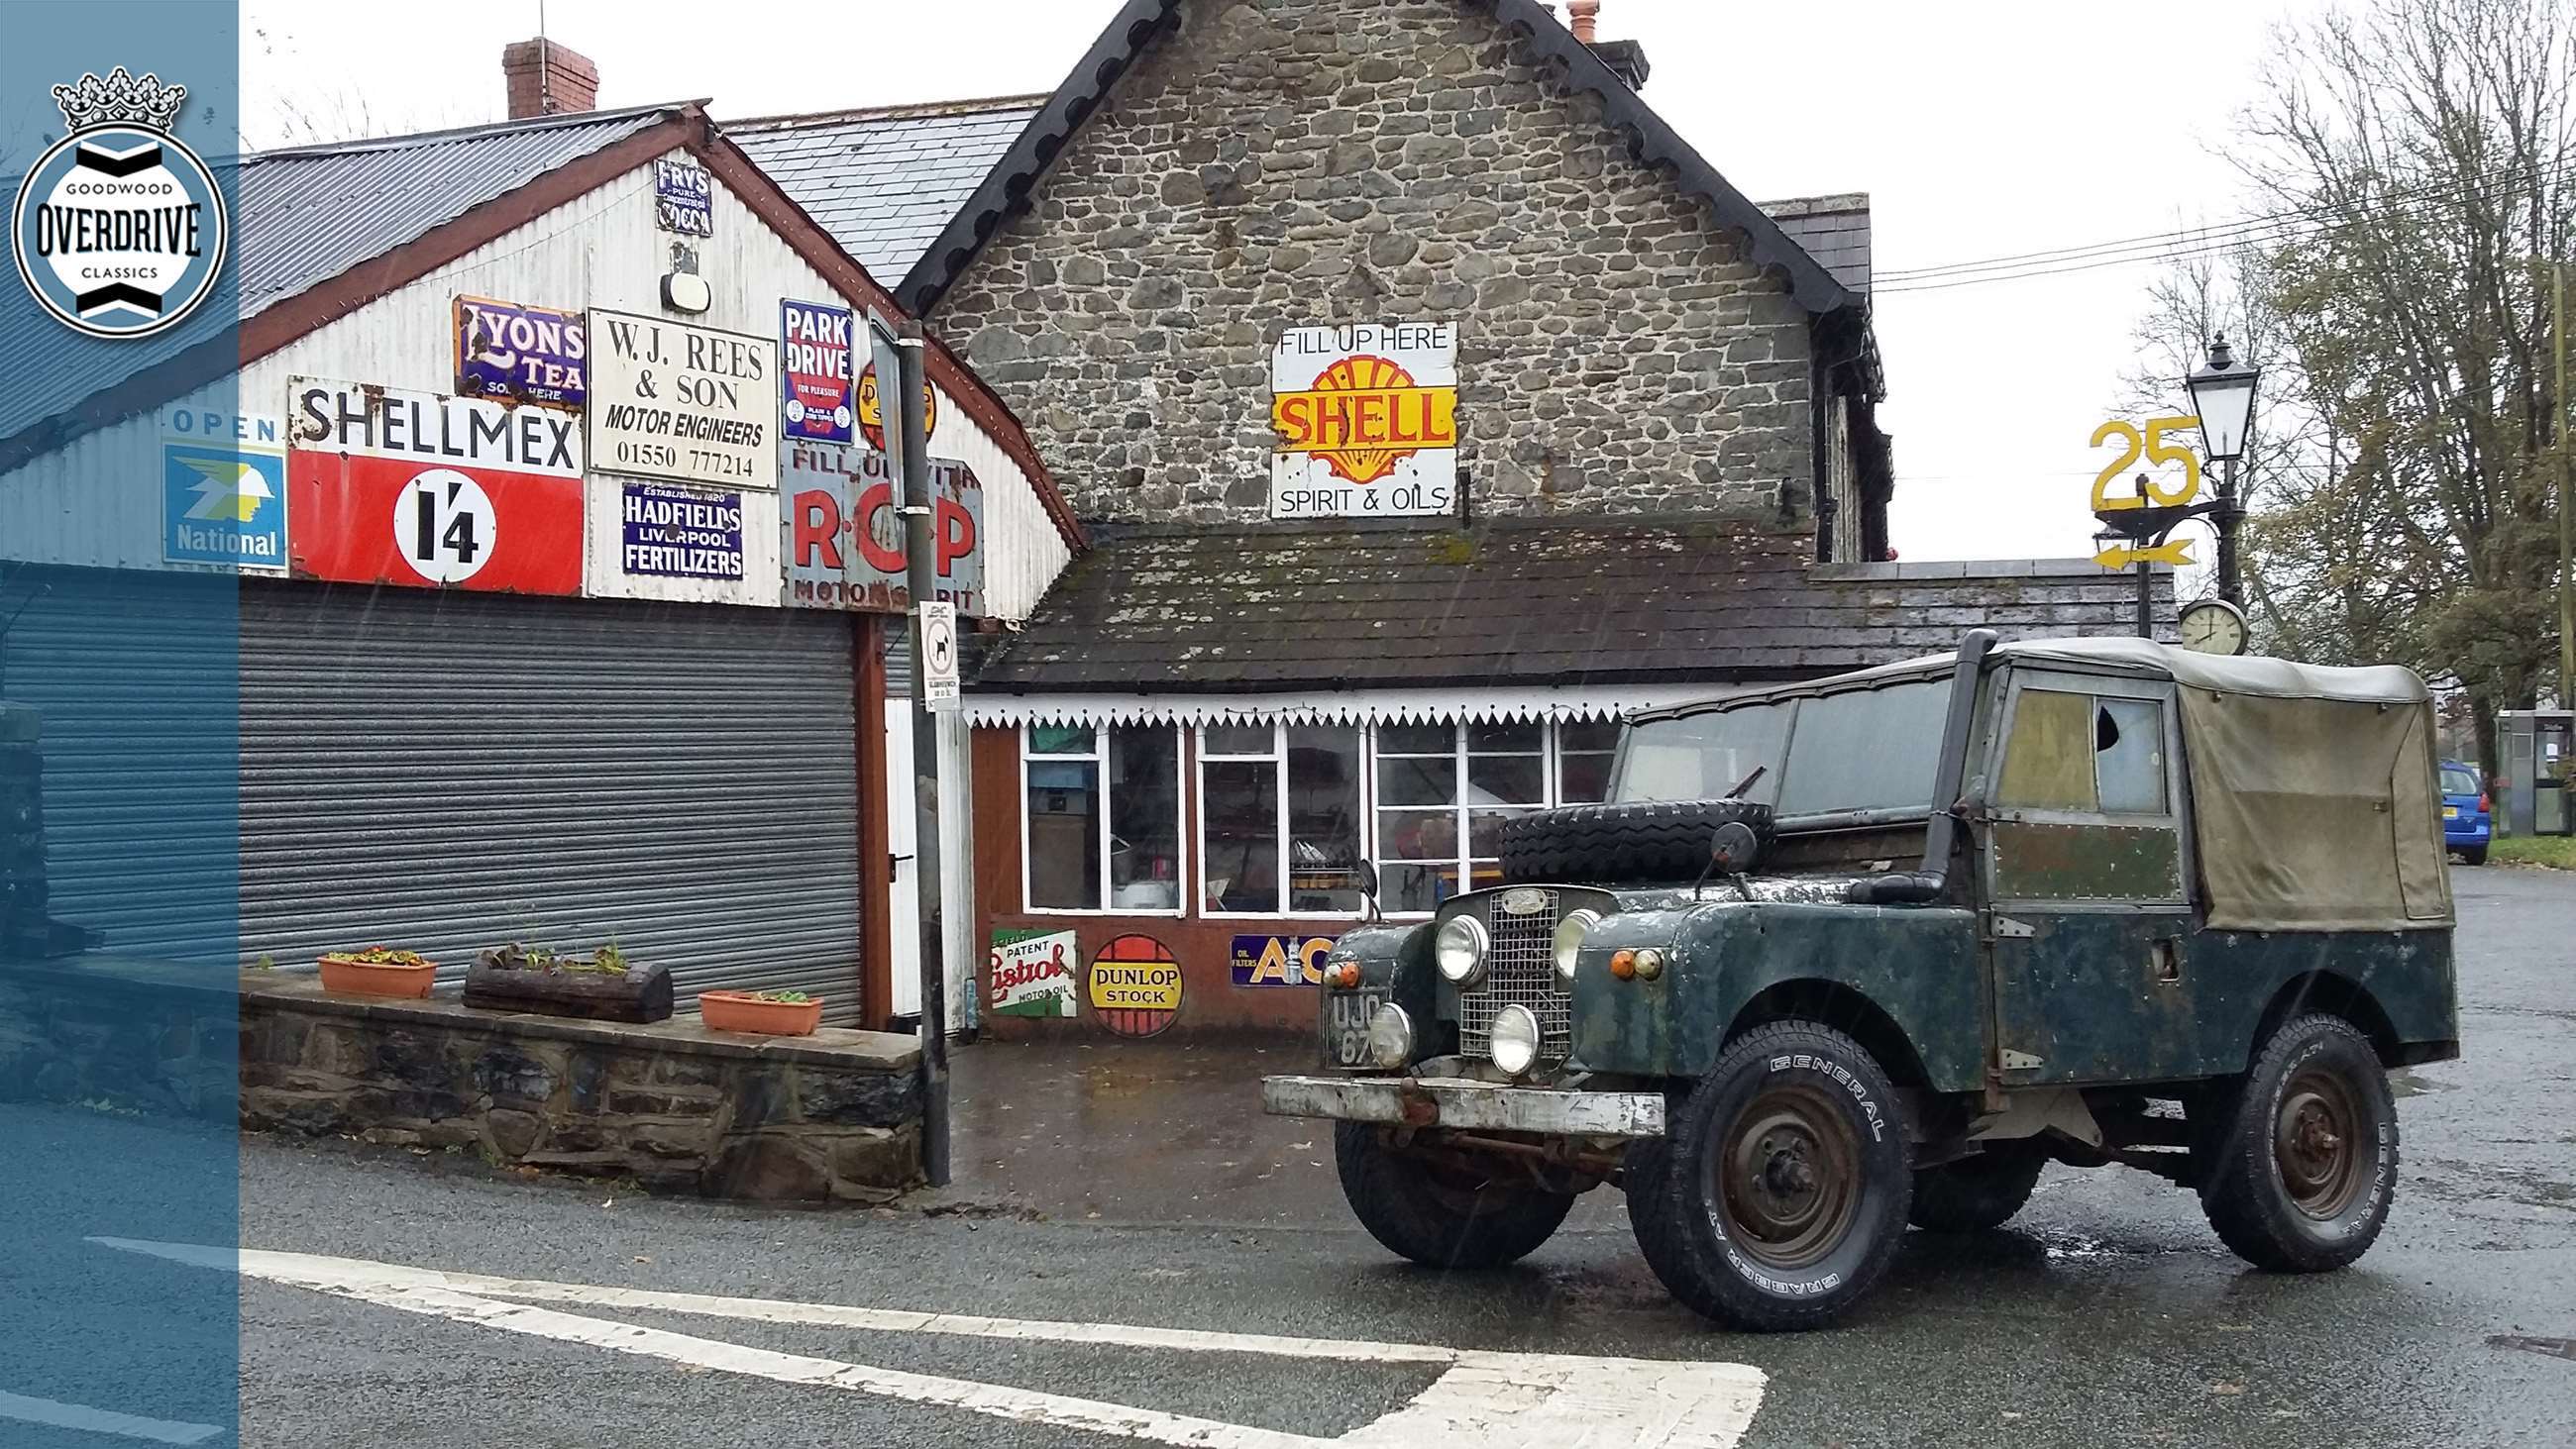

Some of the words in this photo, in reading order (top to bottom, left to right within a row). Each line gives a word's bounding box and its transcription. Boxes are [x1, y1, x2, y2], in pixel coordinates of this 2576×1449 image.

[673, 187, 696, 197] PURE
[462, 304, 585, 369] LYONS
[786, 308, 848, 347] PARK
[1280, 331, 1330, 355] FILL
[1339, 329, 1372, 352] UP
[1381, 327, 1448, 351] HERE
[521, 356, 585, 390] TEA
[685, 333, 763, 381] REES
[787, 343, 849, 380] DRIVE
[635, 369, 658, 399] &
[677, 374, 738, 410] SON
[798, 384, 809, 393] FOR
[810, 386, 840, 397] PLEASURE
[173, 409, 275, 442] OPEN
[605, 404, 672, 435] MOTOR
[673, 413, 763, 447] ENGINEERS
[1280, 393, 1450, 445] SHELL
[617, 441, 676, 467] 01550
[689, 450, 753, 477] 777214
[793, 448, 852, 475] FILL
[863, 455, 890, 479] U
[928, 464, 981, 490] ITH
[2090, 415, 2200, 512] 25
[643, 487, 703, 501] ESTABLISHED
[704, 492, 725, 503] 1820
[1280, 489, 1352, 512] SPIRIT
[1363, 488, 1379, 510] &
[1392, 487, 1447, 510] OILS
[178, 524, 276, 558] National
[626, 544, 742, 575] FERTILIZERS
[1007, 941, 1048, 958] PATENT
[1232, 959, 1257, 968] FILTERS
[1249, 937, 1335, 983] AC
[1052, 984, 1068, 995] OIL
[1096, 969, 1178, 985] DUNLOP
[1107, 990, 1165, 1003] STOCK
[1341, 1029, 1377, 1064] 67
[1771, 1055, 1884, 1142] GENERAL
[1727, 1248, 1840, 1294] GRABBER
